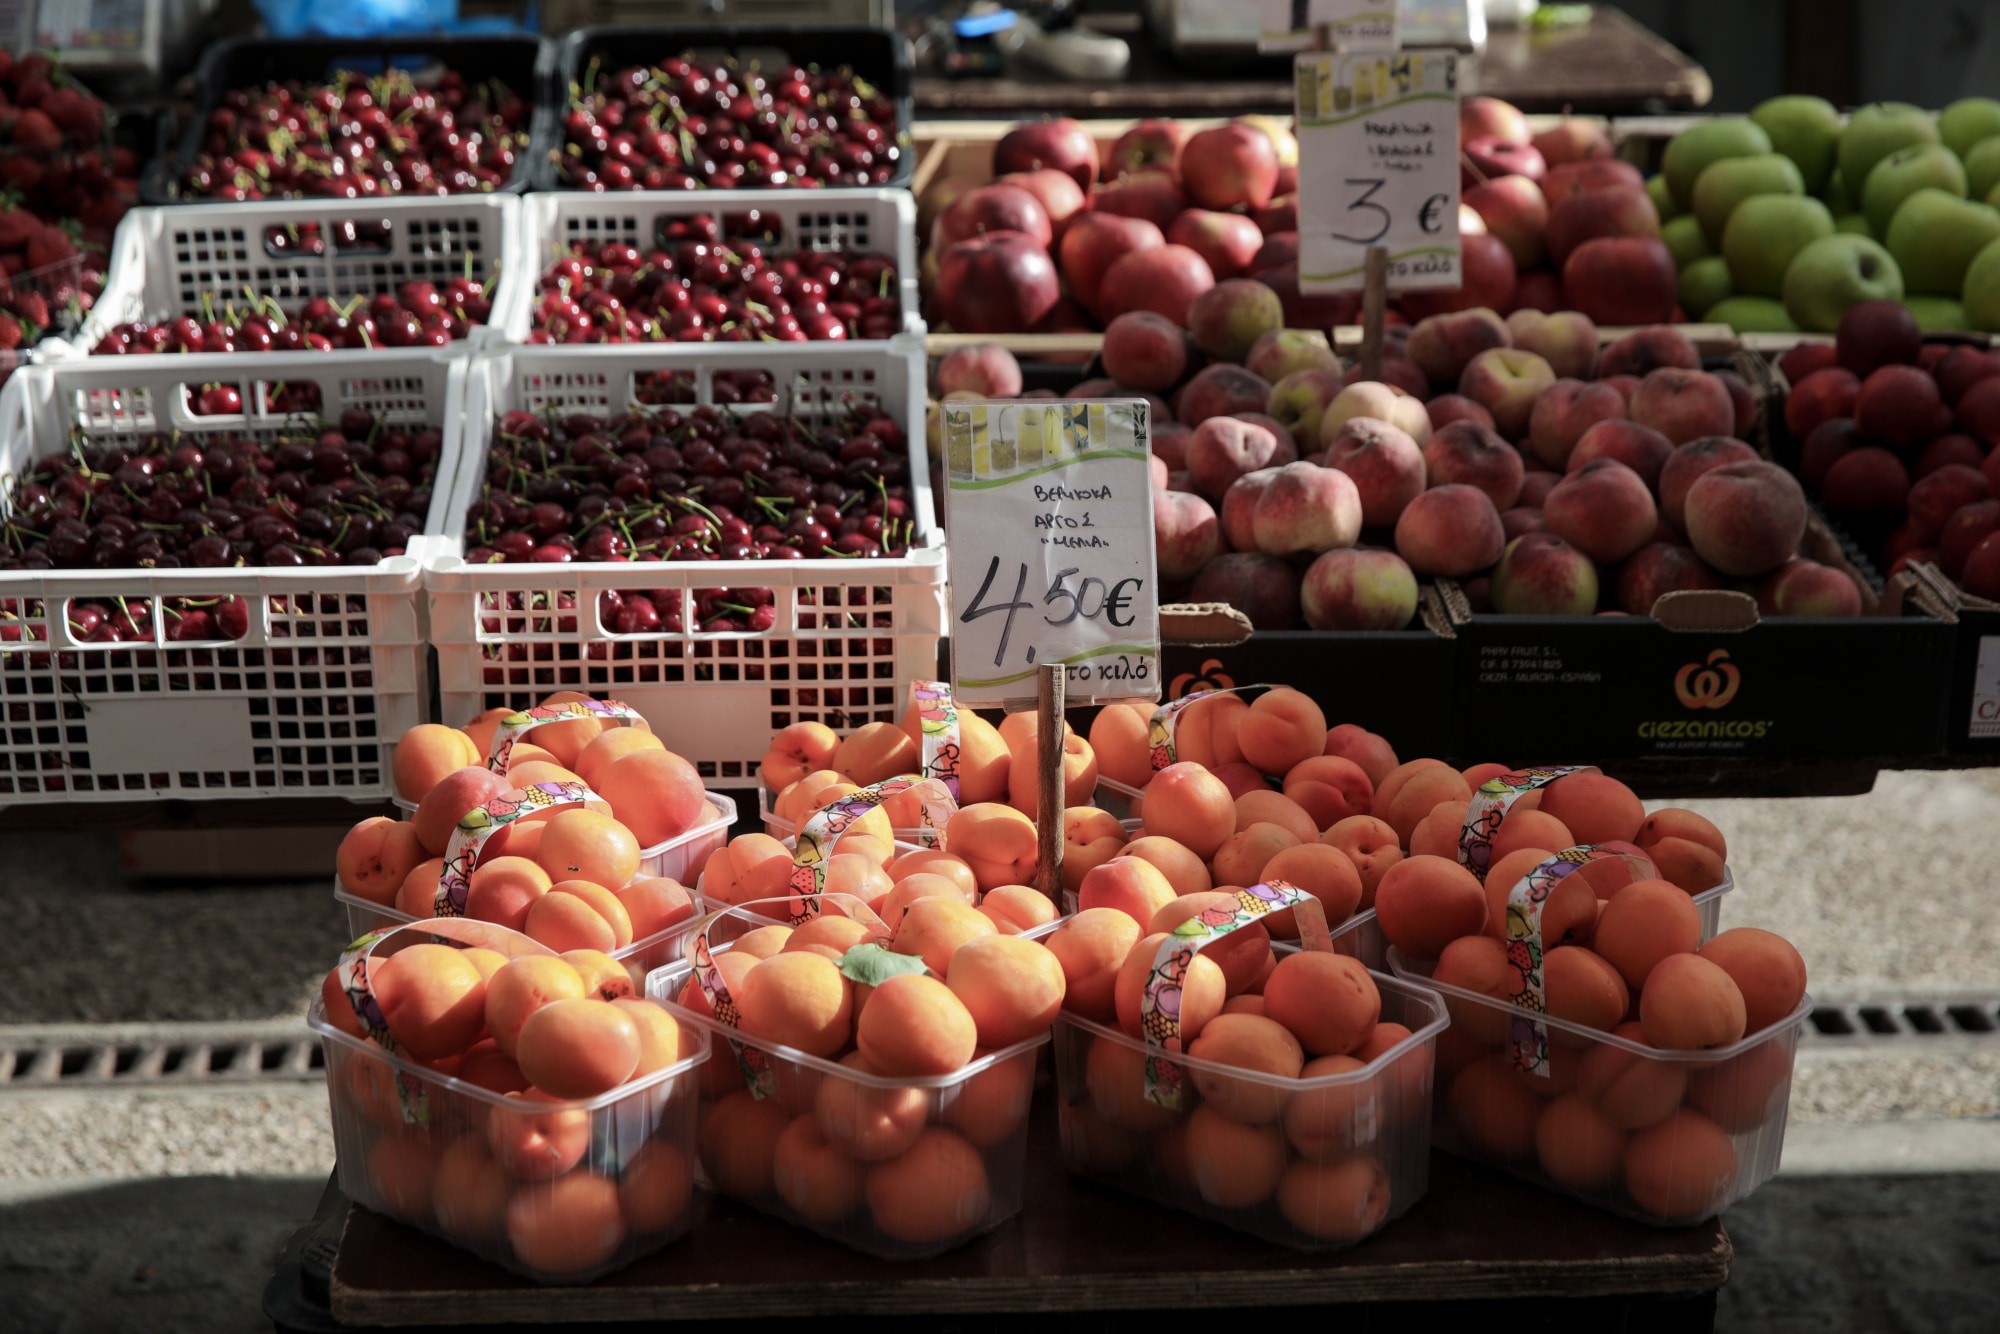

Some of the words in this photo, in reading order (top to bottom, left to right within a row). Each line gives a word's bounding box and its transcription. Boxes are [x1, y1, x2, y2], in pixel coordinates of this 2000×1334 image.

[1332, 178, 1391, 245] 3
[1418, 193, 1448, 235] €
[1065, 665, 1091, 681] το
[1098, 655, 1148, 680] κιλό
[1637, 721, 1768, 738] ciezanicos
